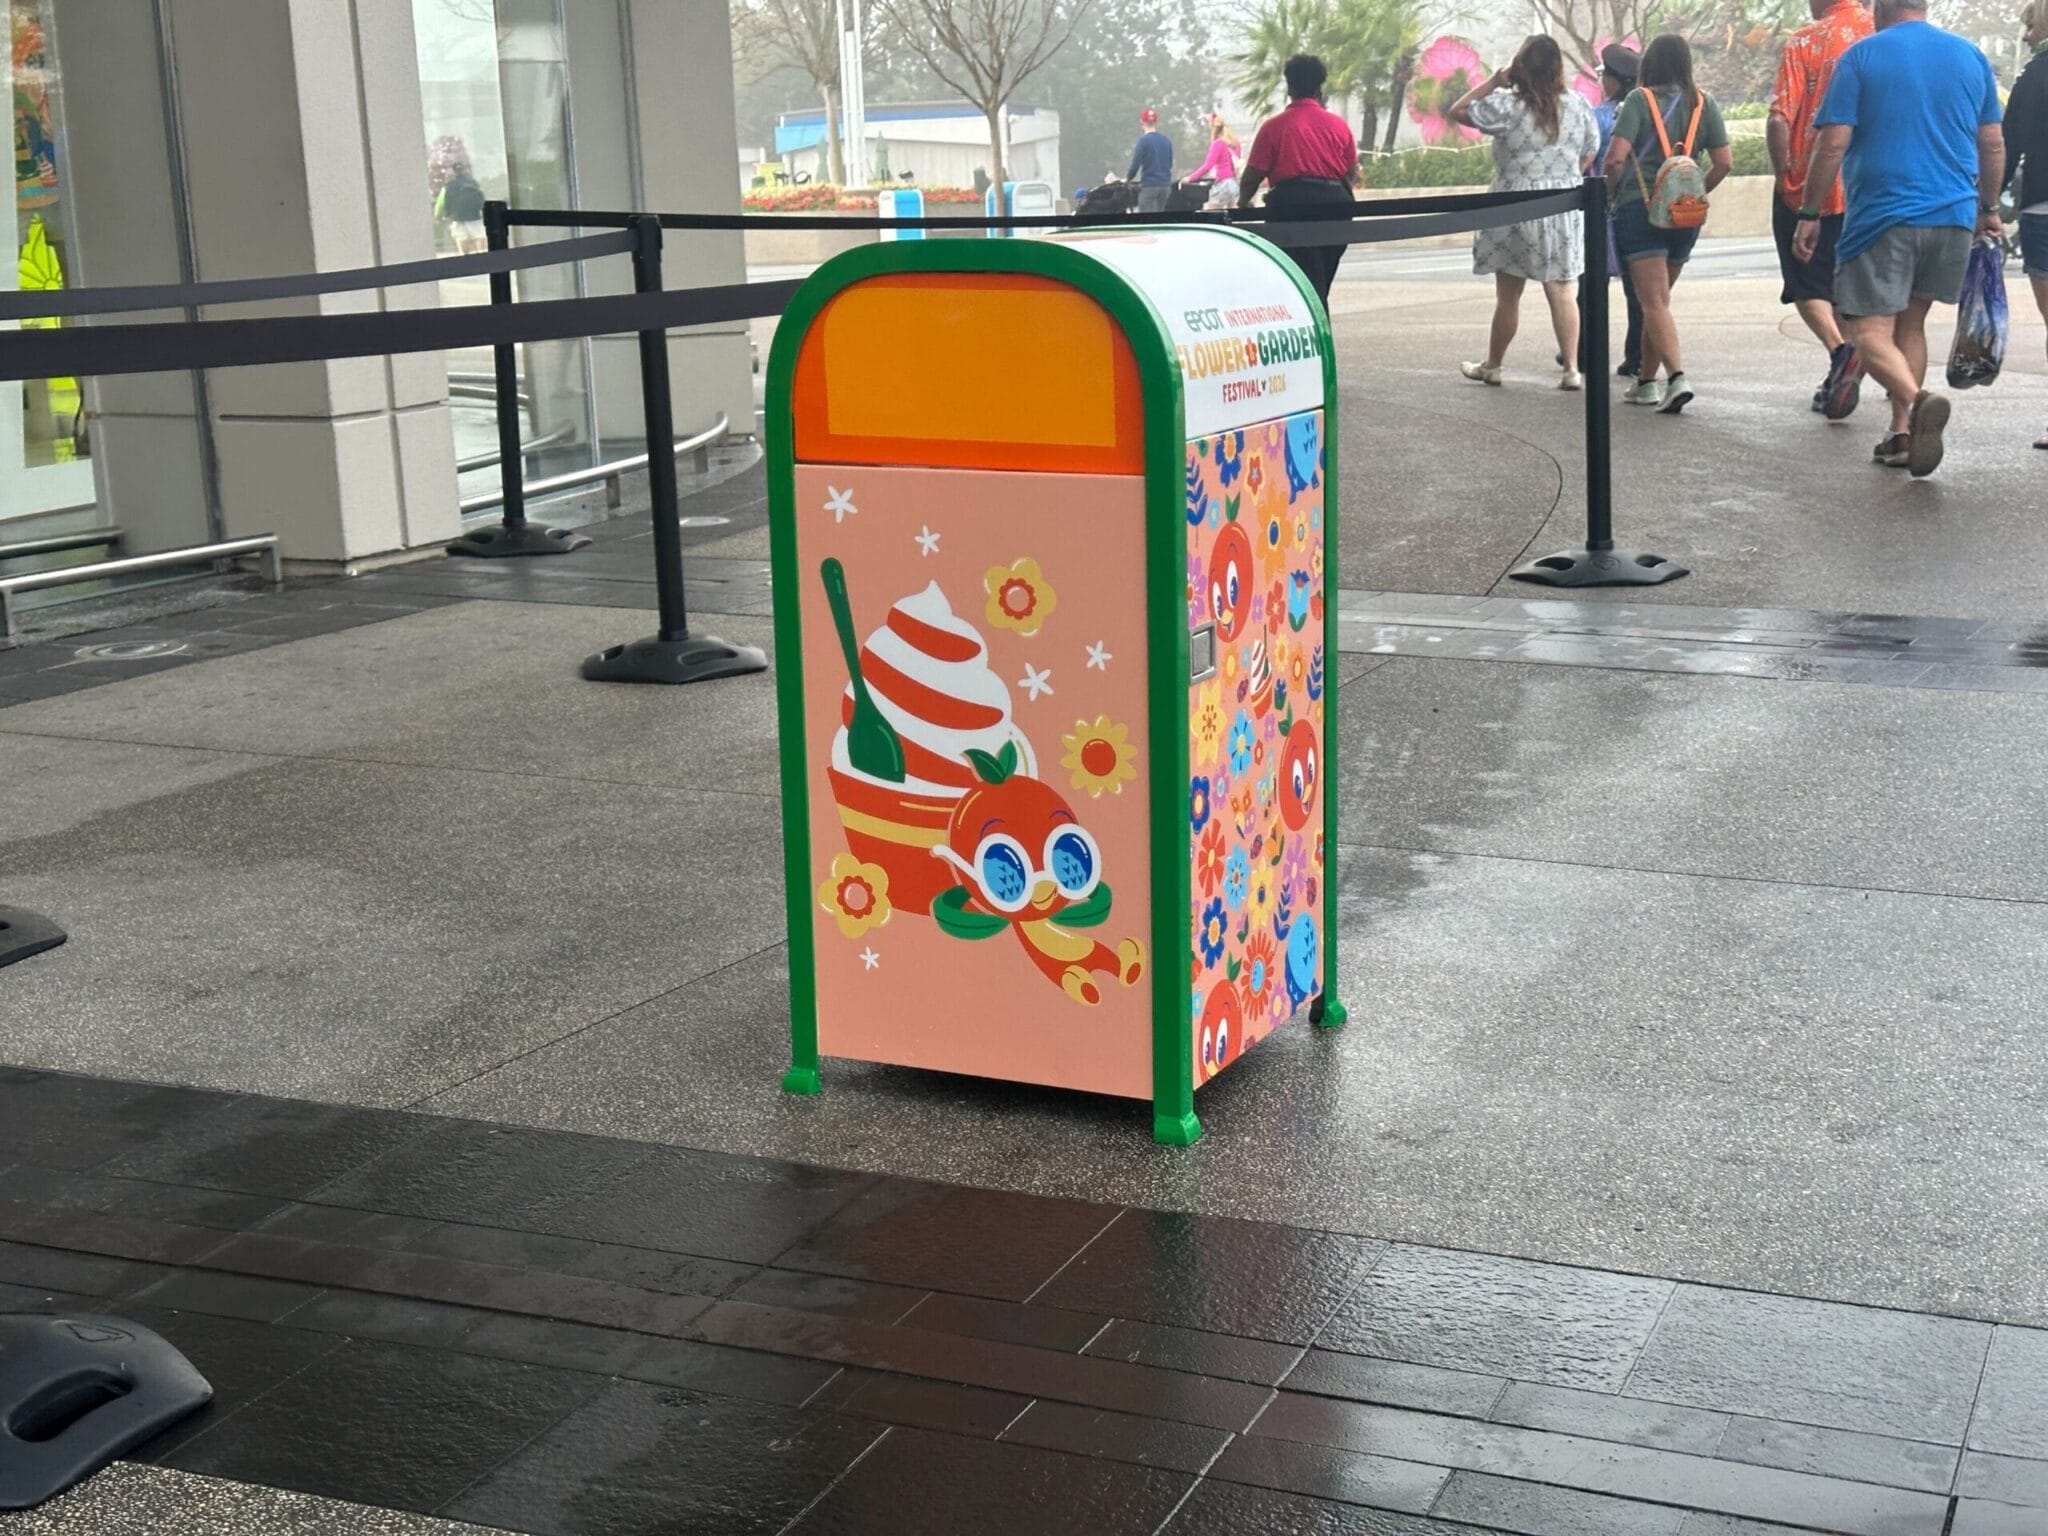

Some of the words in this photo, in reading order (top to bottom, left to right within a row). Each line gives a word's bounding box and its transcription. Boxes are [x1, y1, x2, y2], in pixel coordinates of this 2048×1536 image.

[1184, 308, 1224, 332] EPCOT
[1223, 304, 1292, 327] INTERNATIONAL
[1257, 324, 1322, 366] GARDEN
[1223, 378, 1261, 403] FESTIVAL
